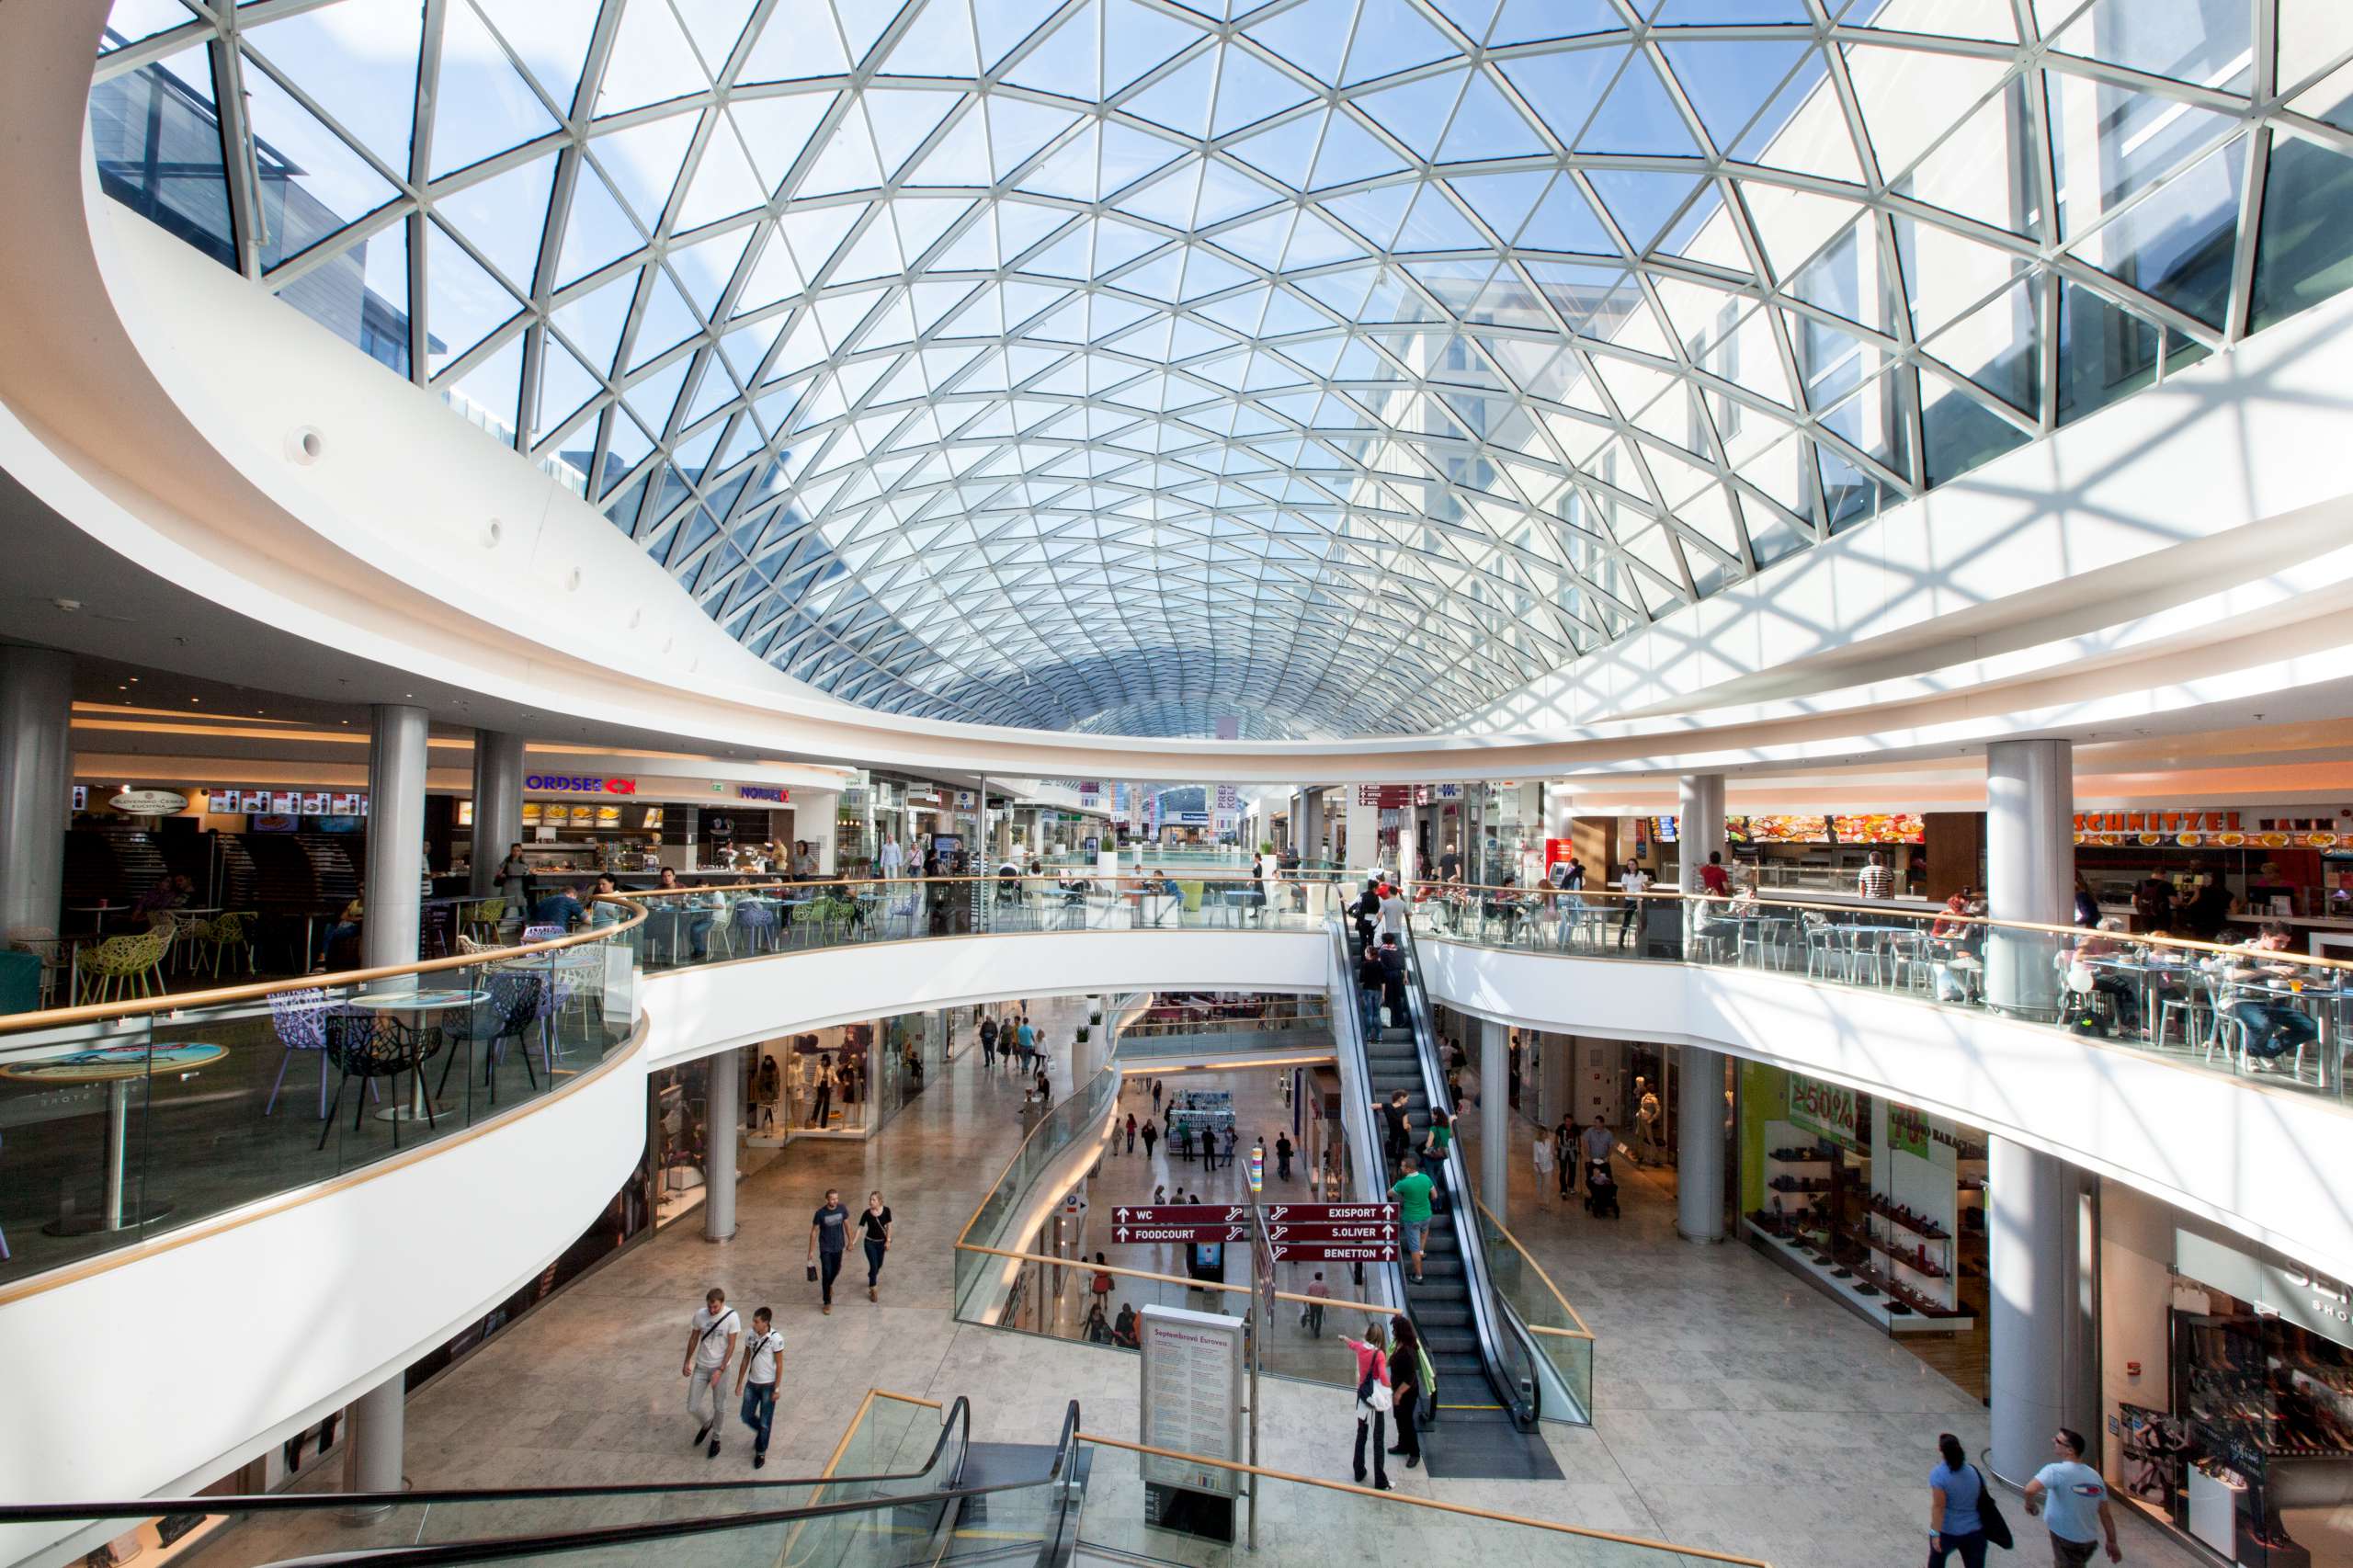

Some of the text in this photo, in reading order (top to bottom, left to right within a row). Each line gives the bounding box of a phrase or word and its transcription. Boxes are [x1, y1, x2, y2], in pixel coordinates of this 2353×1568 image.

[527, 777, 602, 791] ORDSEE
[2074, 812, 2245, 832] SCHNITZEL
[1136, 1210, 1153, 1220] WC
[1328, 1208, 1377, 1218] EXISPORT
[1135, 1230, 1195, 1239] FOODCOURT
[1332, 1228, 1376, 1237] S.OLIVER
[1324, 1249, 1377, 1258] BENETTON
[2312, 1300, 2353, 1324] SHO
